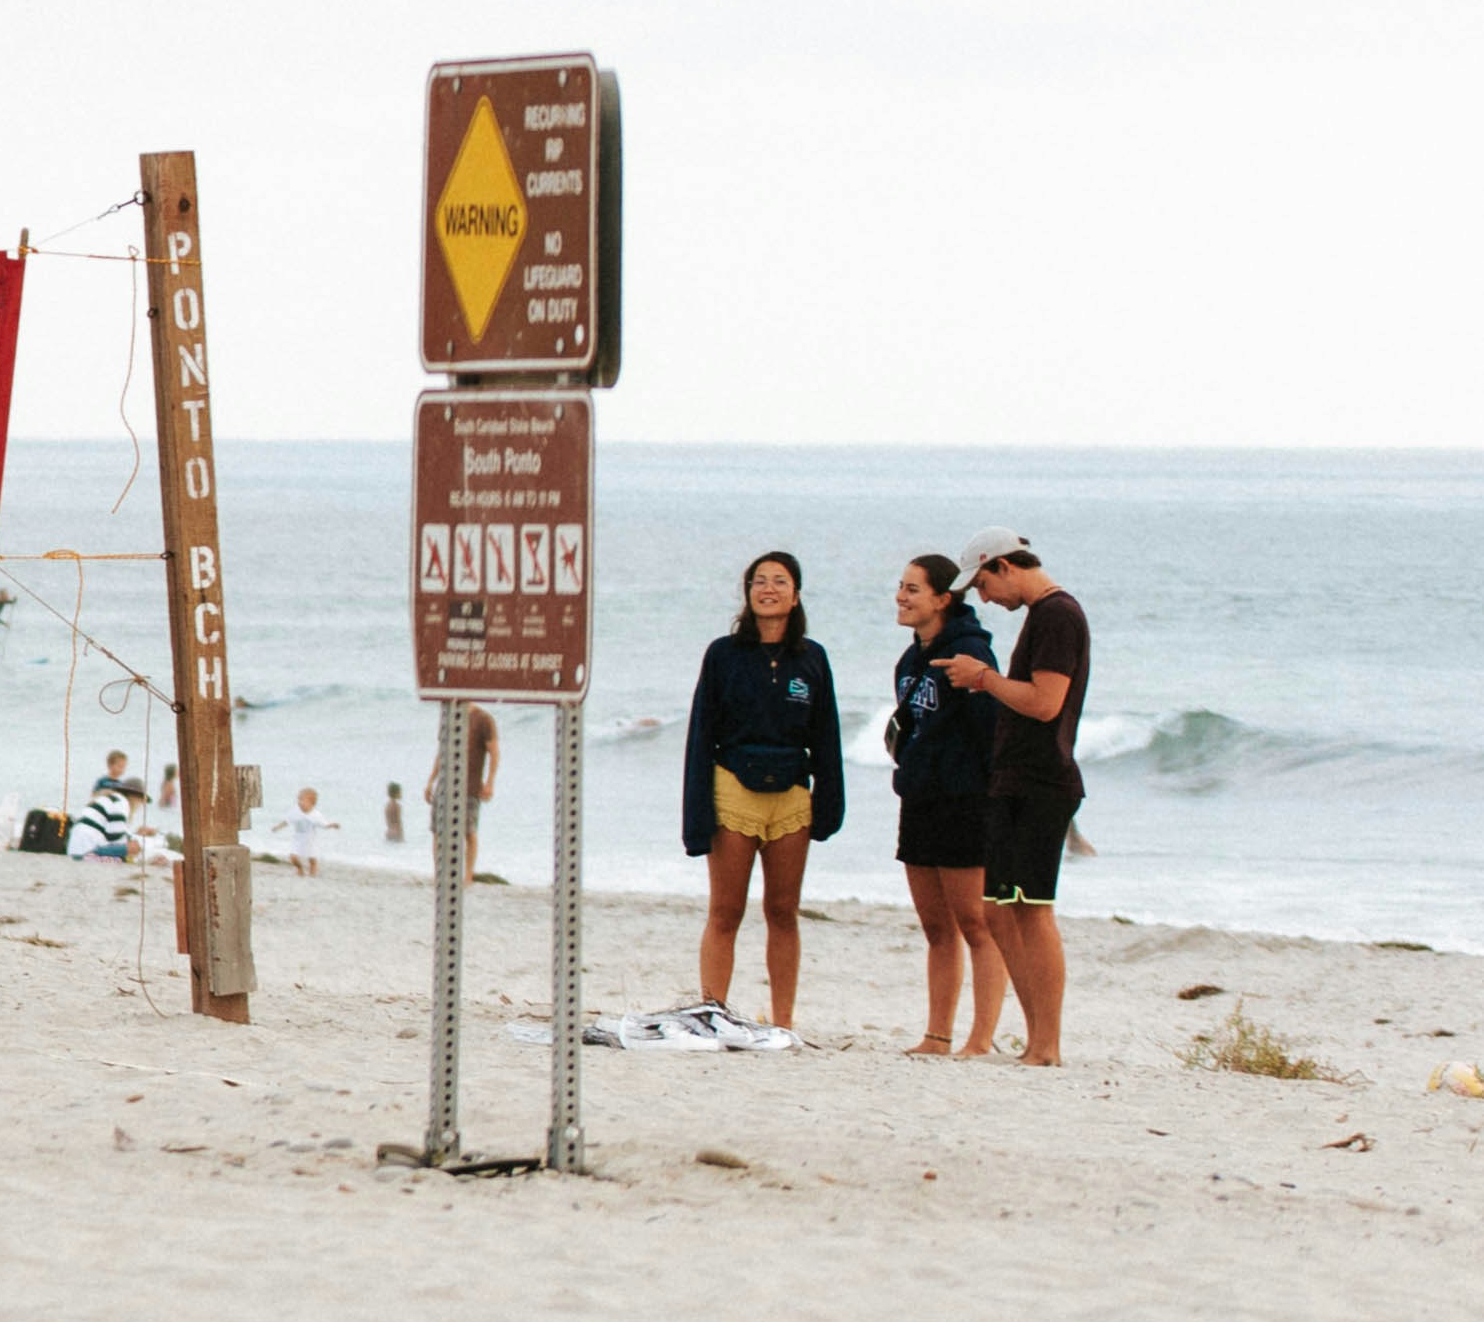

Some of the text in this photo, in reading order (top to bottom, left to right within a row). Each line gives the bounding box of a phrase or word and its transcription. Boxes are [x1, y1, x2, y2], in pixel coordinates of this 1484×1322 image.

[526, 169, 582, 197] CURRENTS
[444, 204, 518, 237] WARNING
[544, 231, 562, 256] NO
[523, 264, 583, 290] LIFEGUARD
[527, 297, 577, 323] ON DUTY
[167, 231, 223, 700] PONTO BCH
[464, 446, 540, 475] South Ponto
